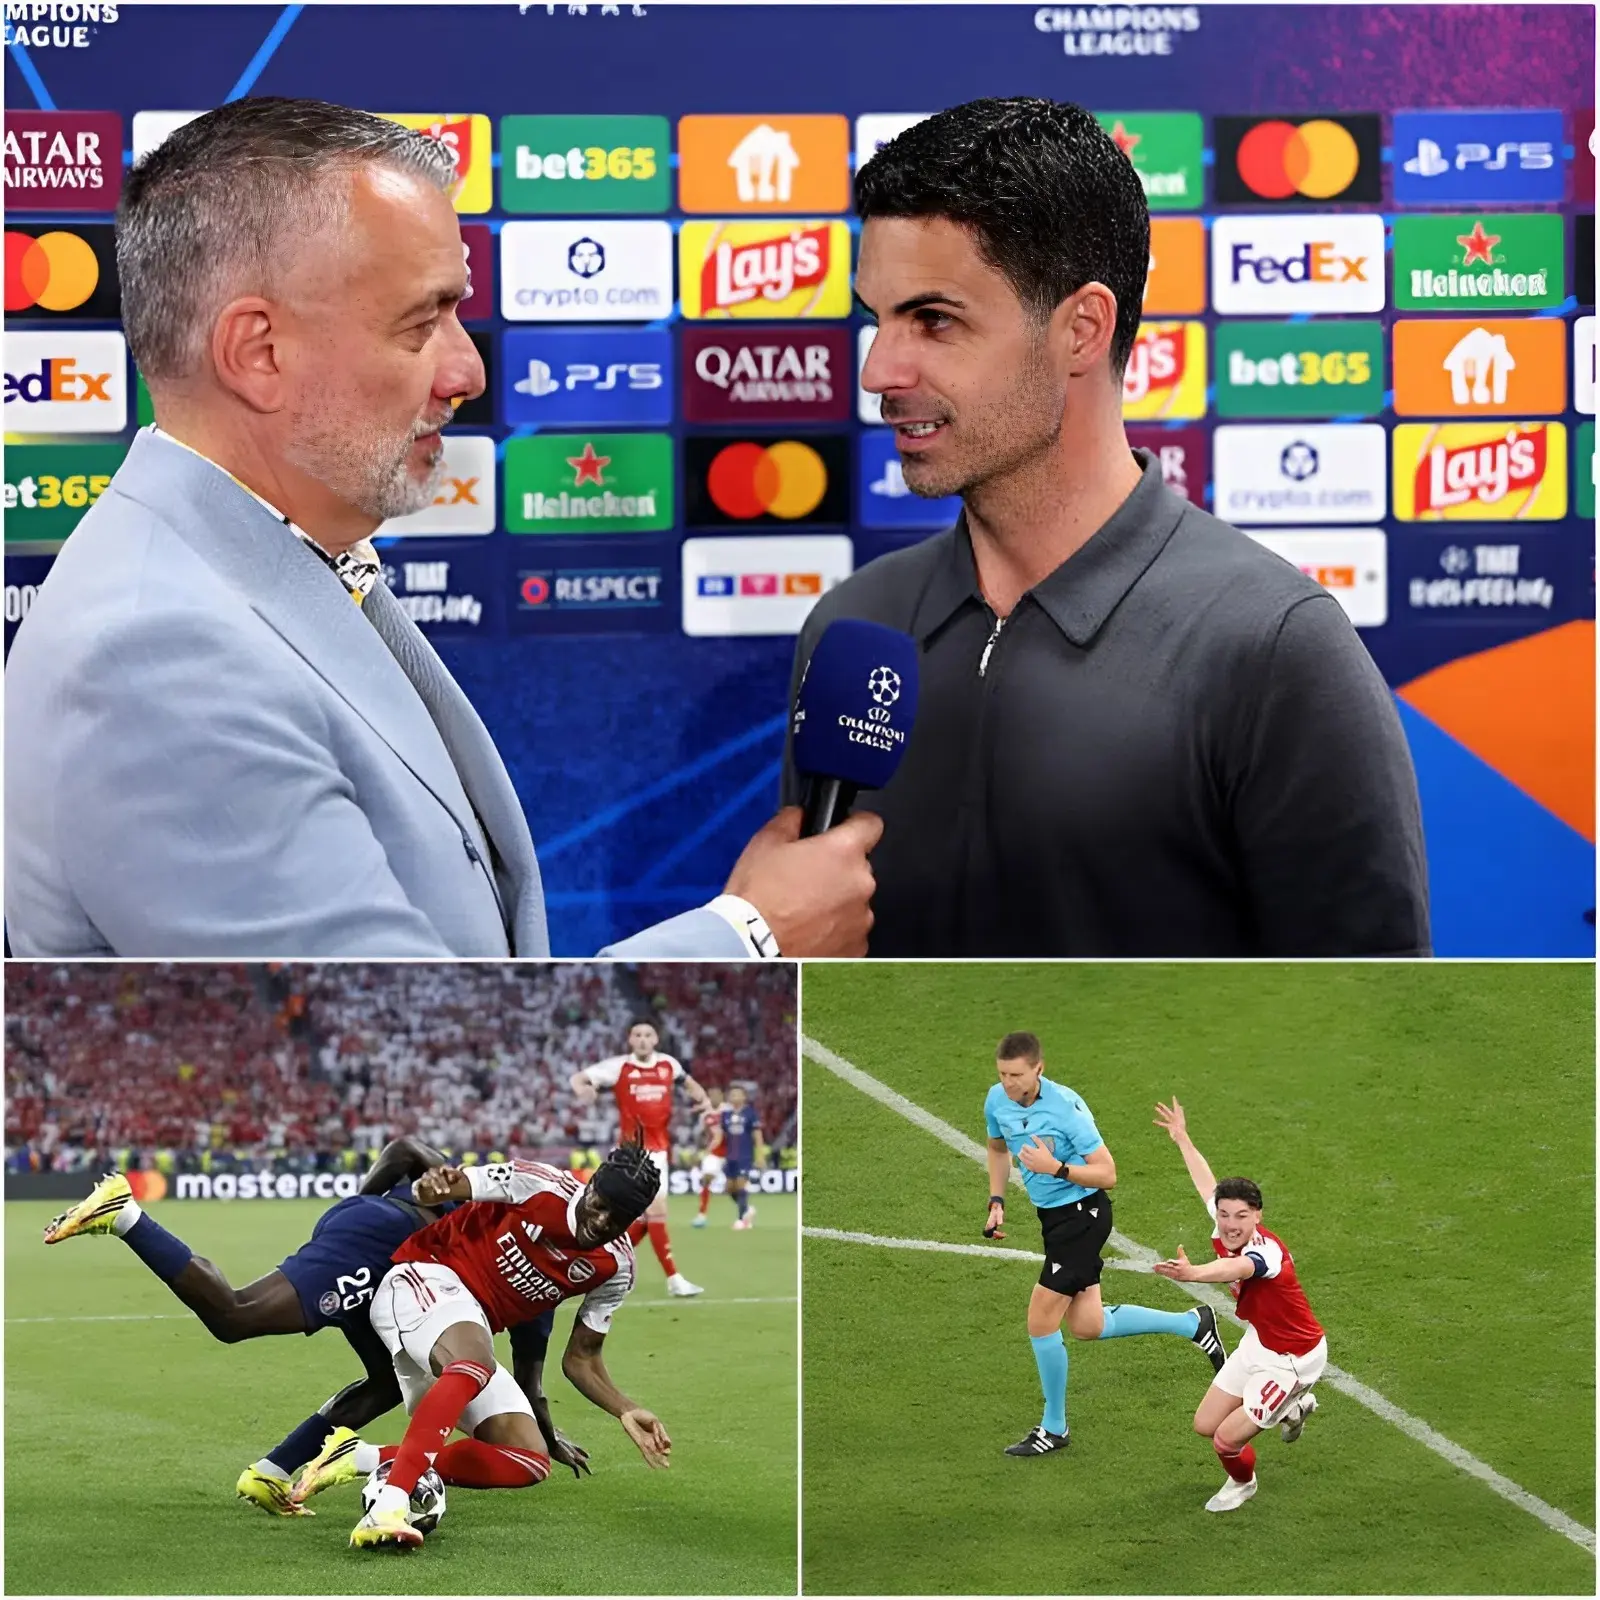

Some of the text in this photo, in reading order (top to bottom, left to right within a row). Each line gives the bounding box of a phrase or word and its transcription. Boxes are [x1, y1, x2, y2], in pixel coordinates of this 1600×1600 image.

[5, 4, 119, 24] MPIONS
[1034, 6, 1200, 32] CHAMPIONS
[1063, 33, 1173, 56] LEAGUE
[4, 131, 102, 166] ATAR
[515, 145, 656, 180] bet365
[1456, 143, 1554, 171] PS5
[4, 167, 104, 188] AIRWAYS
[716, 232, 820, 304] Lay's
[1232, 242, 1368, 283] FedEx
[4, 358, 112, 403] edEx
[566, 363, 663, 391] PS5
[695, 345, 830, 388] QATAR
[1229, 350, 1371, 386] bet365
[1430, 430, 1536, 508] Lay's
[4, 475, 112, 508] et365
[522, 491, 657, 520] Heineken
[175, 1172, 362, 1200] masterca
[336, 1266, 374, 1311] 25
[1261, 1380, 1286, 1411] 41
